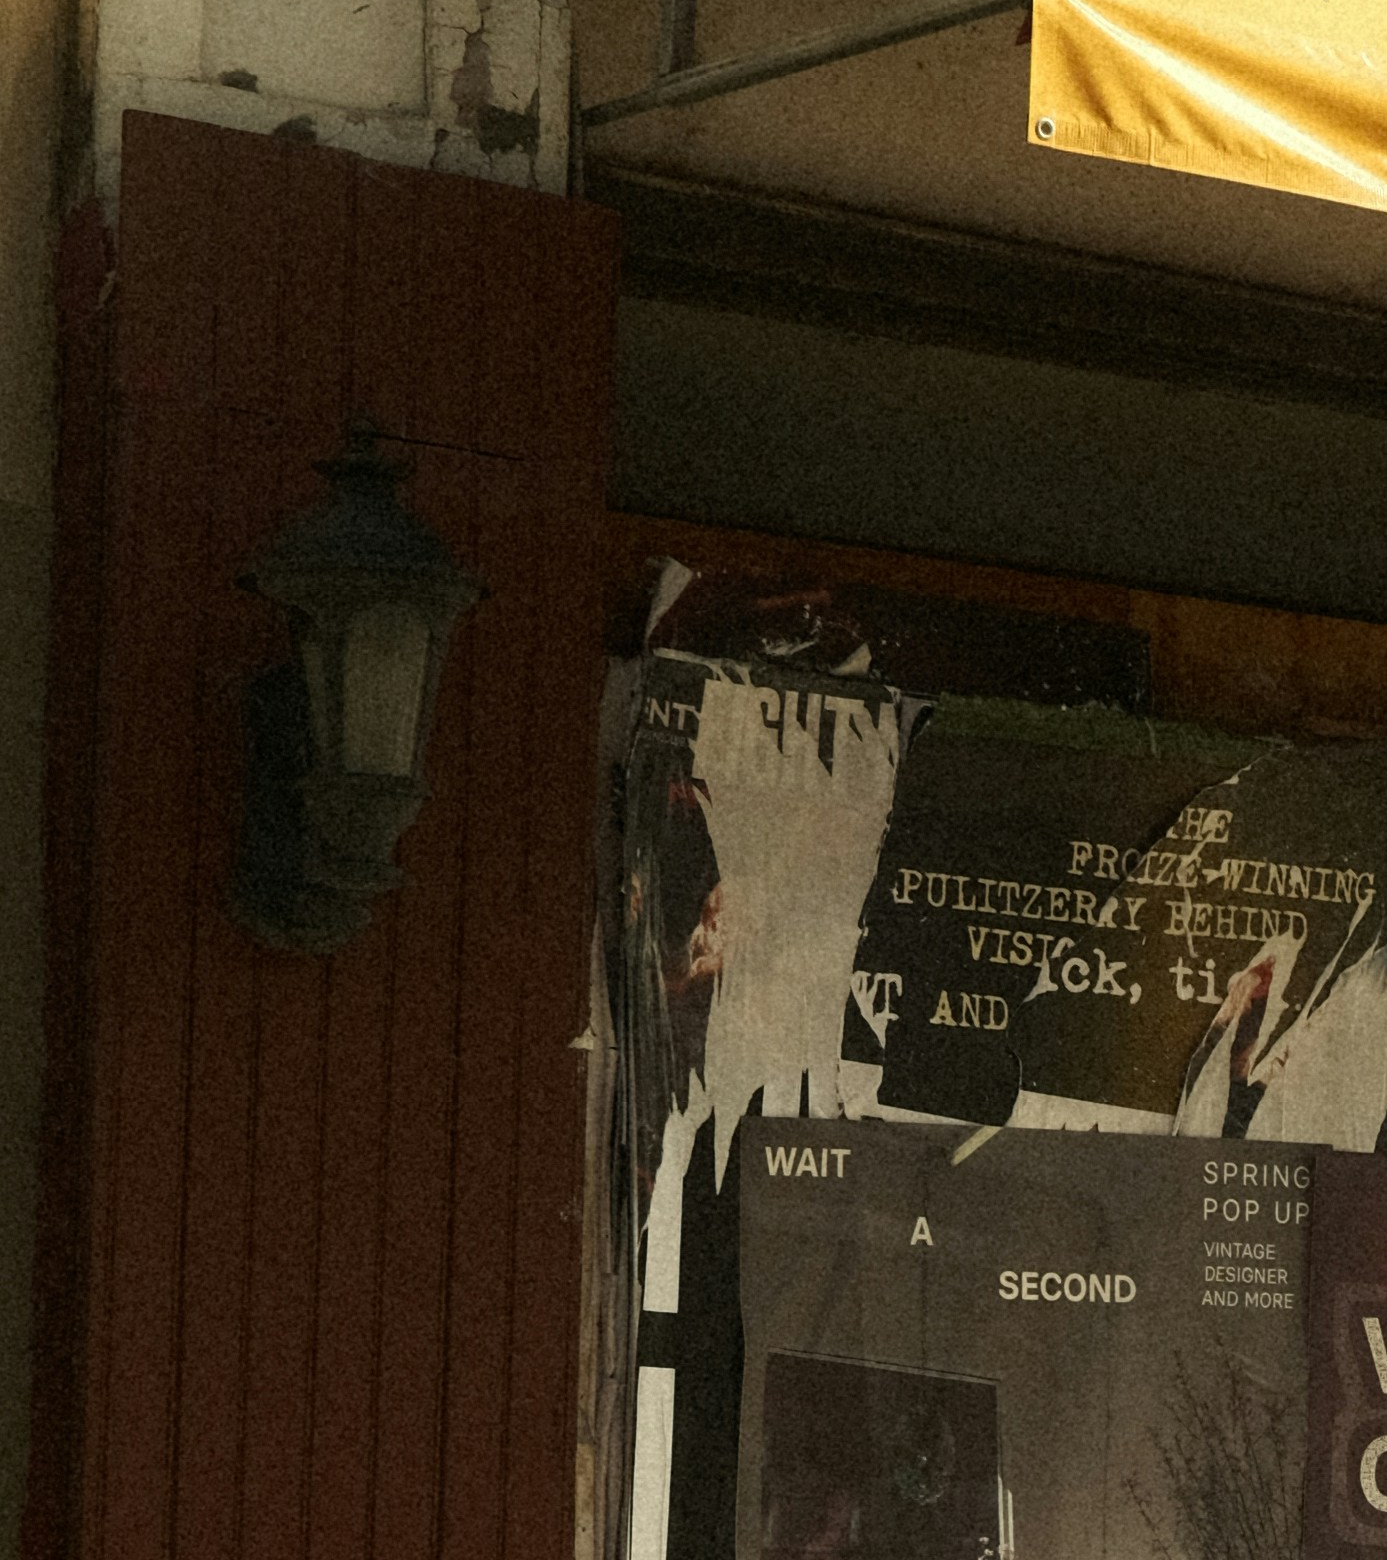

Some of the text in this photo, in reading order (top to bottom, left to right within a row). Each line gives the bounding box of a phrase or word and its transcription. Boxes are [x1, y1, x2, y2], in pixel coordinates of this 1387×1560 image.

[1165, 900, 1308, 944] BEHIND
[929, 990, 1009, 1031] AND
[765, 1147, 851, 1178] WAIT
[1203, 1161, 1311, 1189] SPRING
[1203, 1198, 1311, 1225] POP UP
[910, 1216, 934, 1246] A
[1203, 1241, 1277, 1260] VINTAGE
[999, 1271, 1137, 1303] SECOND
[1204, 1266, 1289, 1286] DESIGNER
[1202, 1291, 1294, 1310] AND MORE
